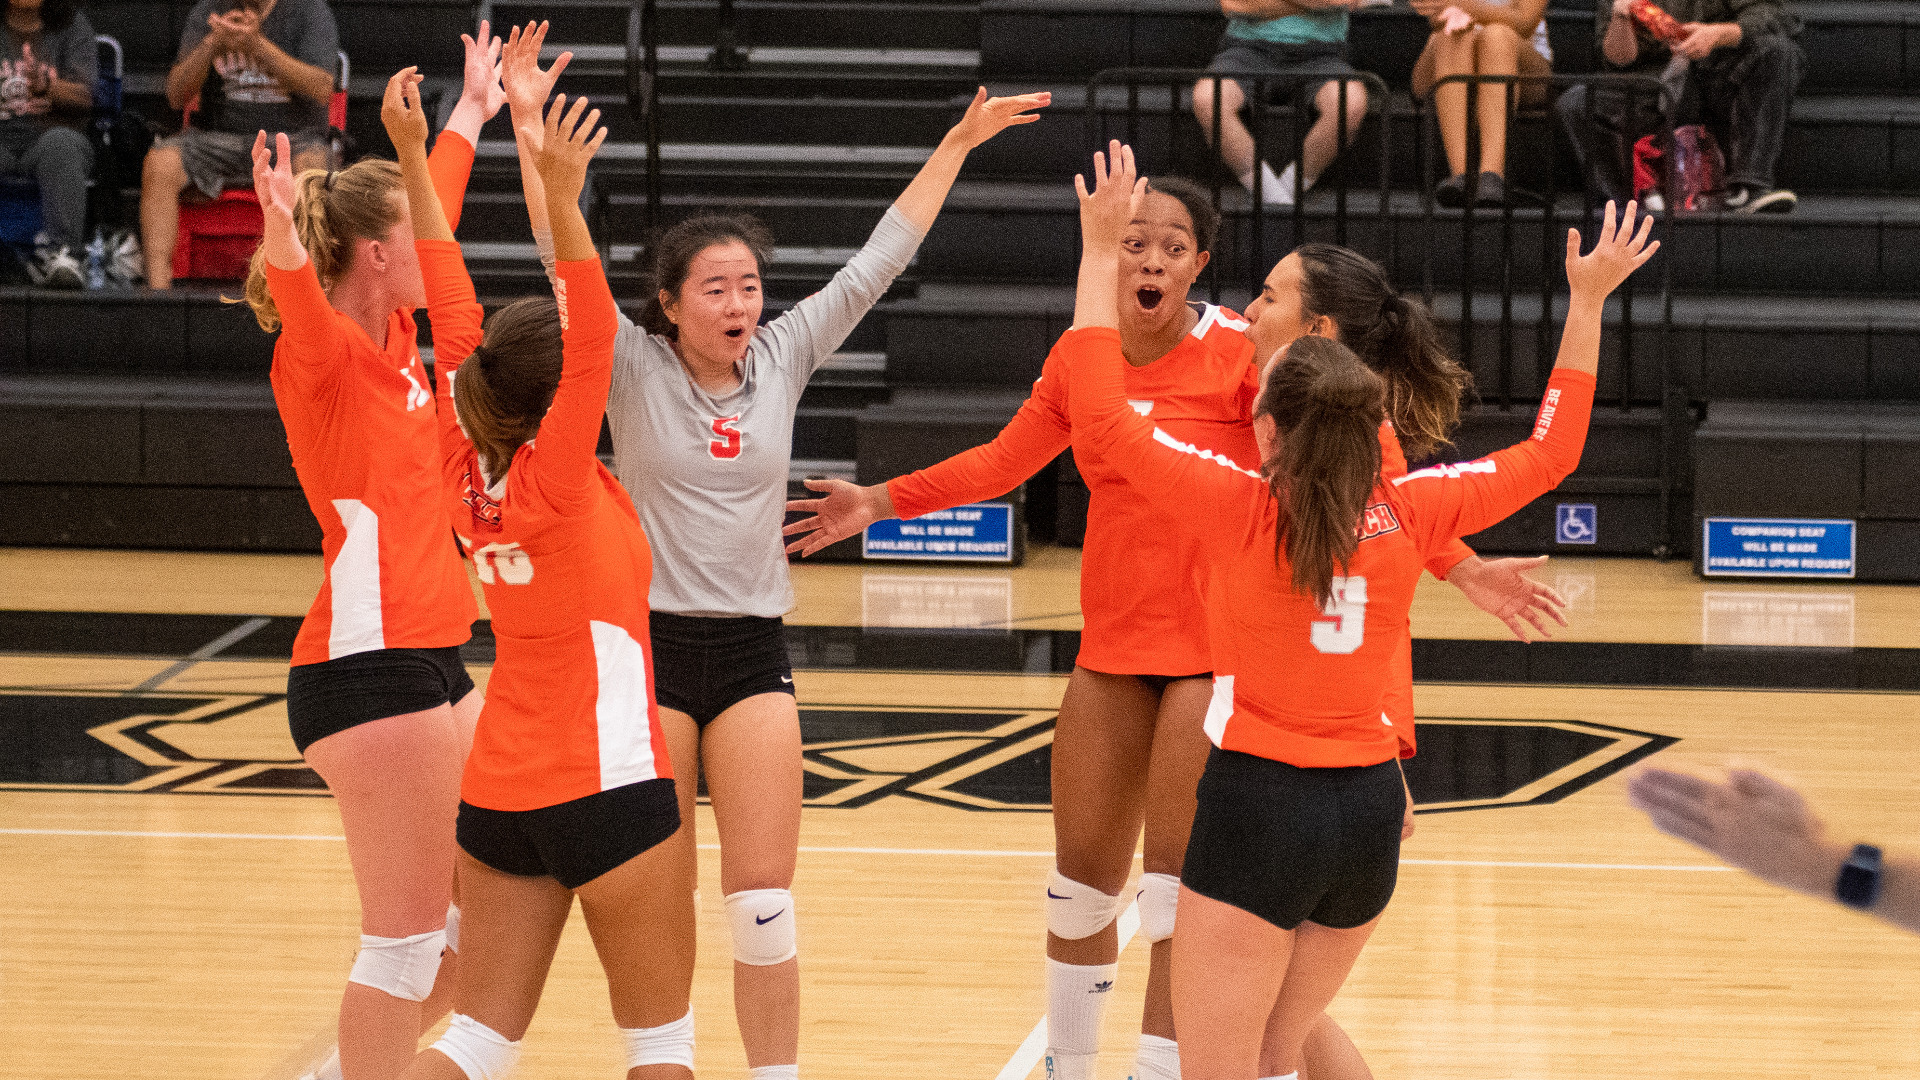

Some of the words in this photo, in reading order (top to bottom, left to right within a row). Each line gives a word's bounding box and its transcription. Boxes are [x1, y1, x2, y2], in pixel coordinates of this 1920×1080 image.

[1533, 388, 1561, 441] BEAVERS
[709, 413, 742, 460] 5
[900, 525, 925, 536] WILL
[927, 526, 942, 536] BE
[944, 526, 975, 536] MADE
[1731, 526, 1797, 537] COMPANION
[1798, 527, 1826, 537] SEAT
[868, 540, 924, 550] AVAILABLE
[1742, 542, 1768, 552] WILL
[1770, 542, 1785, 552] BE
[1786, 543, 1818, 553] MADE
[1709, 557, 1766, 567] AVAILABLE
